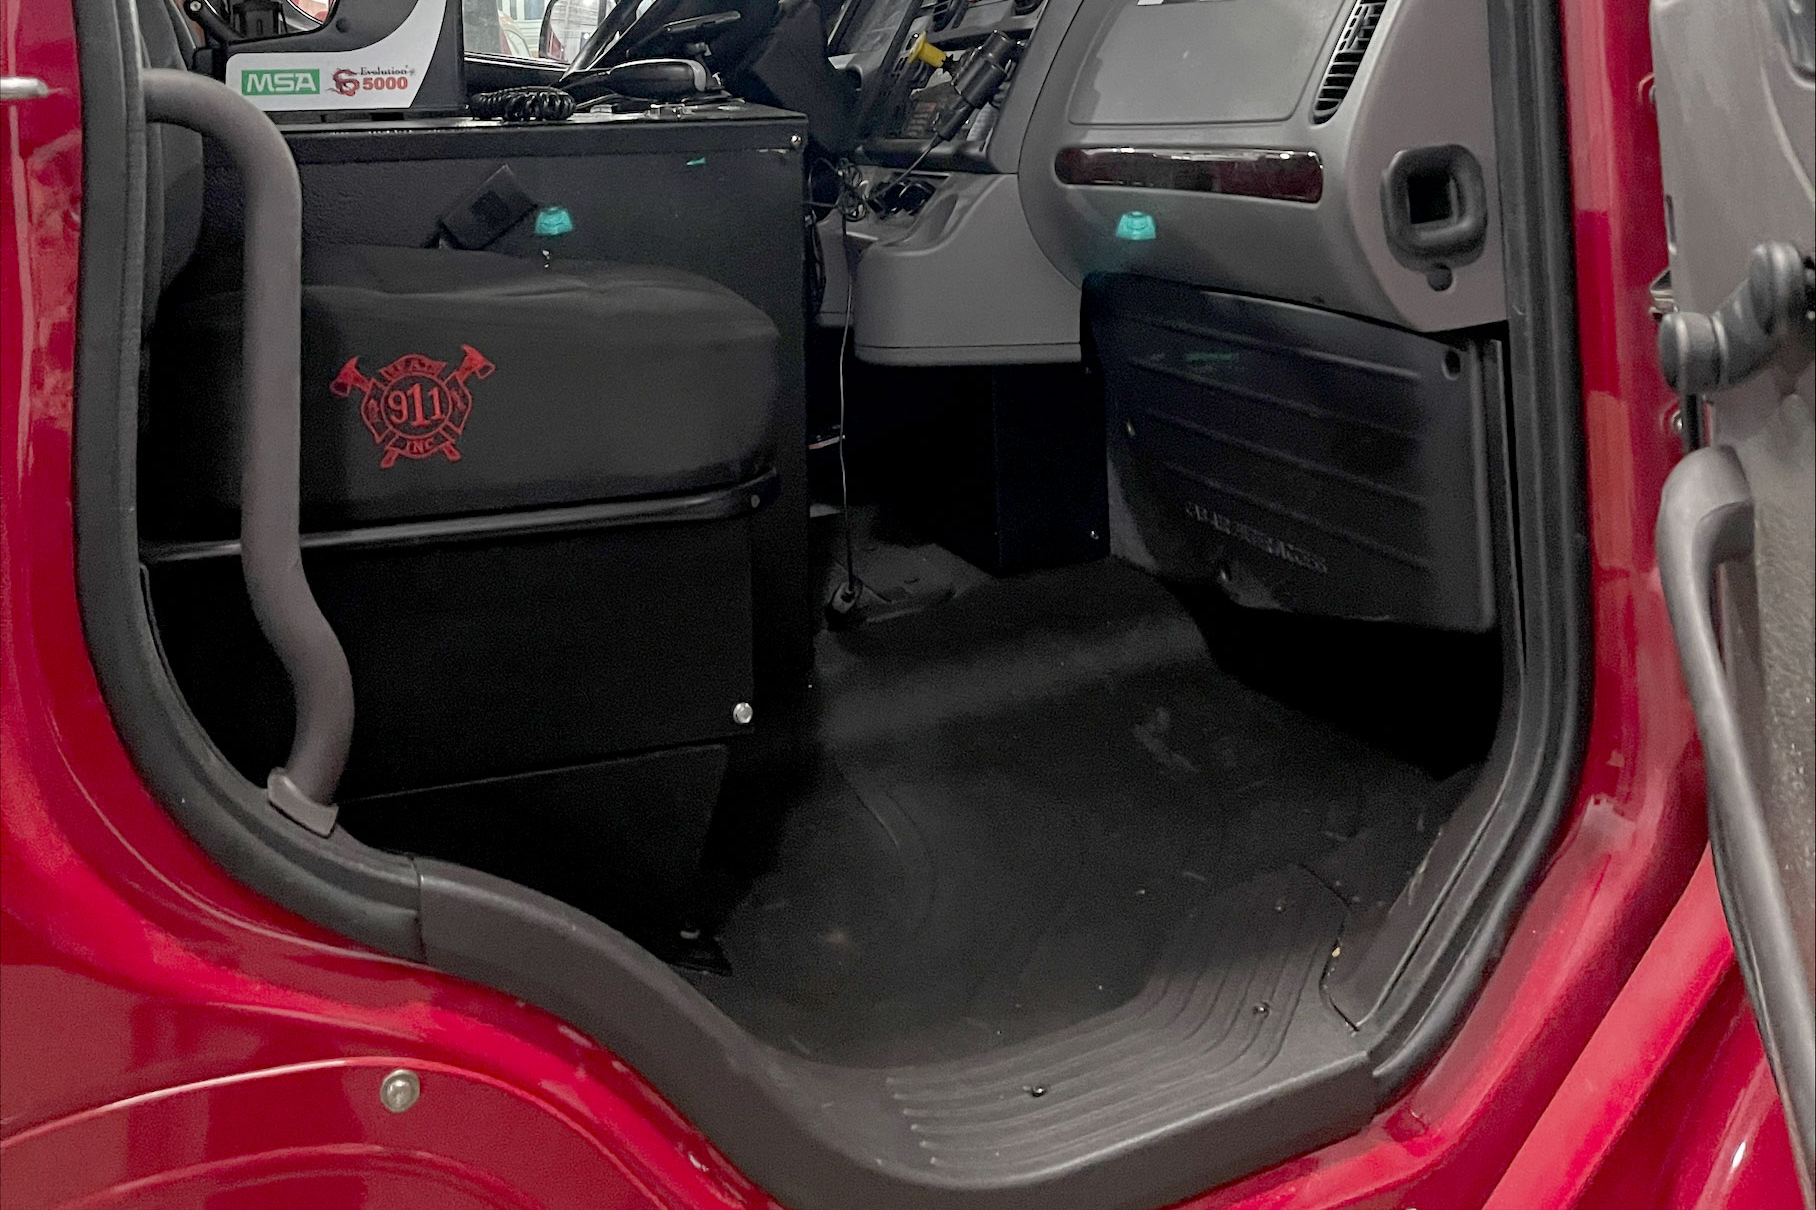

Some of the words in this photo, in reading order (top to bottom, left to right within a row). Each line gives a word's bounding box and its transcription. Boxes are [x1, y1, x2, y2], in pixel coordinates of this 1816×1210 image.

[361, 66, 407, 76] Evolution
[246, 73, 317, 93] MSA
[363, 76, 408, 90] 5000
[388, 383, 446, 427] 911
[406, 436, 435, 452] INC
